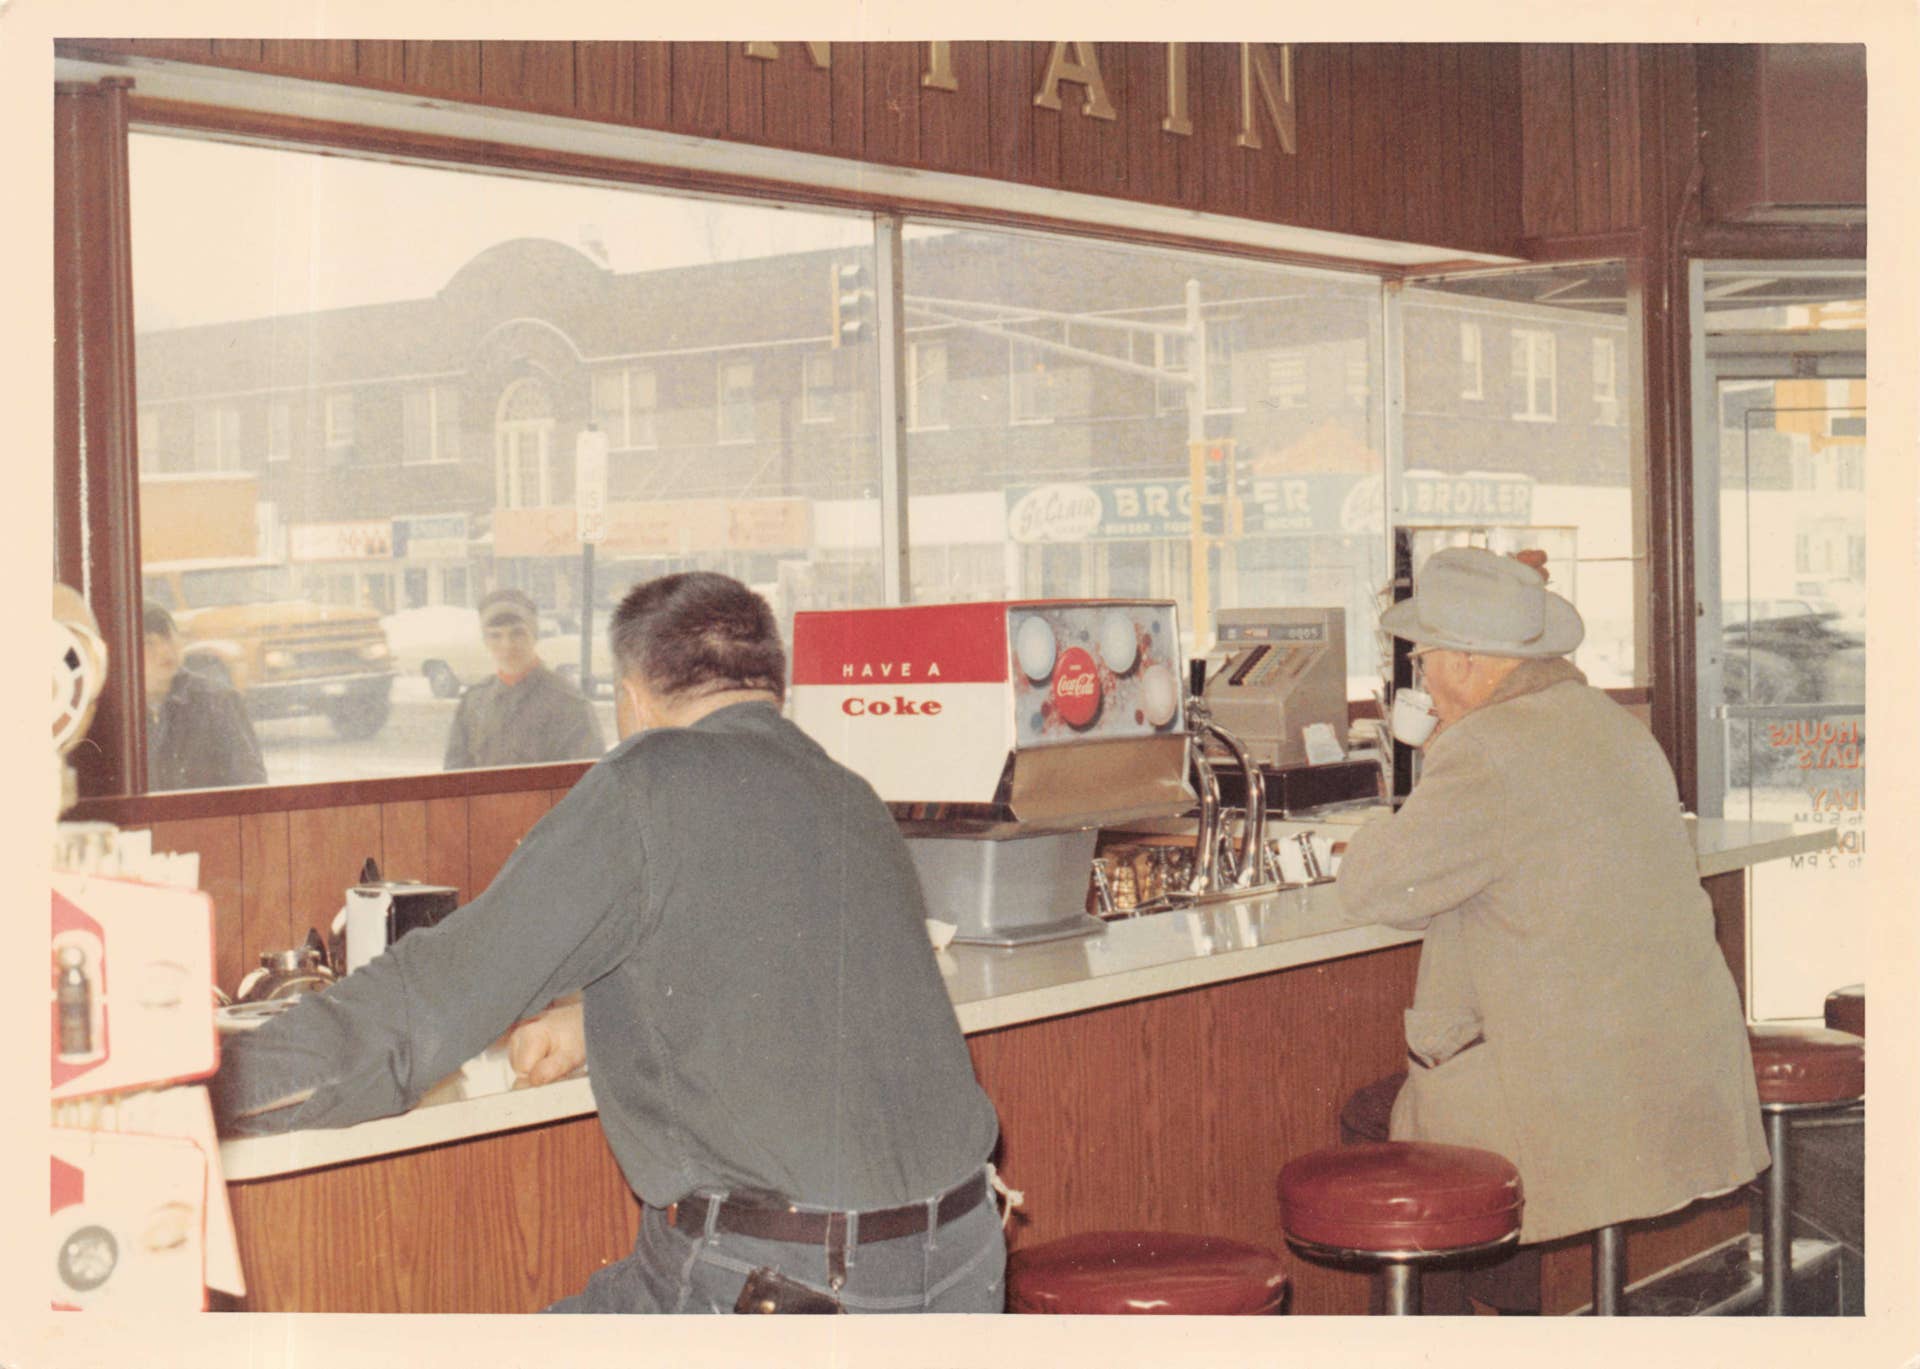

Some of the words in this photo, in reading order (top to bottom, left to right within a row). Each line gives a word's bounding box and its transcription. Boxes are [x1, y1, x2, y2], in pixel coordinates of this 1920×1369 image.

[1112, 480, 1311, 517] BROER
[1416, 481, 1528, 513] BROILER
[842, 662, 911, 678] HAVE
[927, 661, 941, 677] A
[841, 696, 943, 716] Coke
